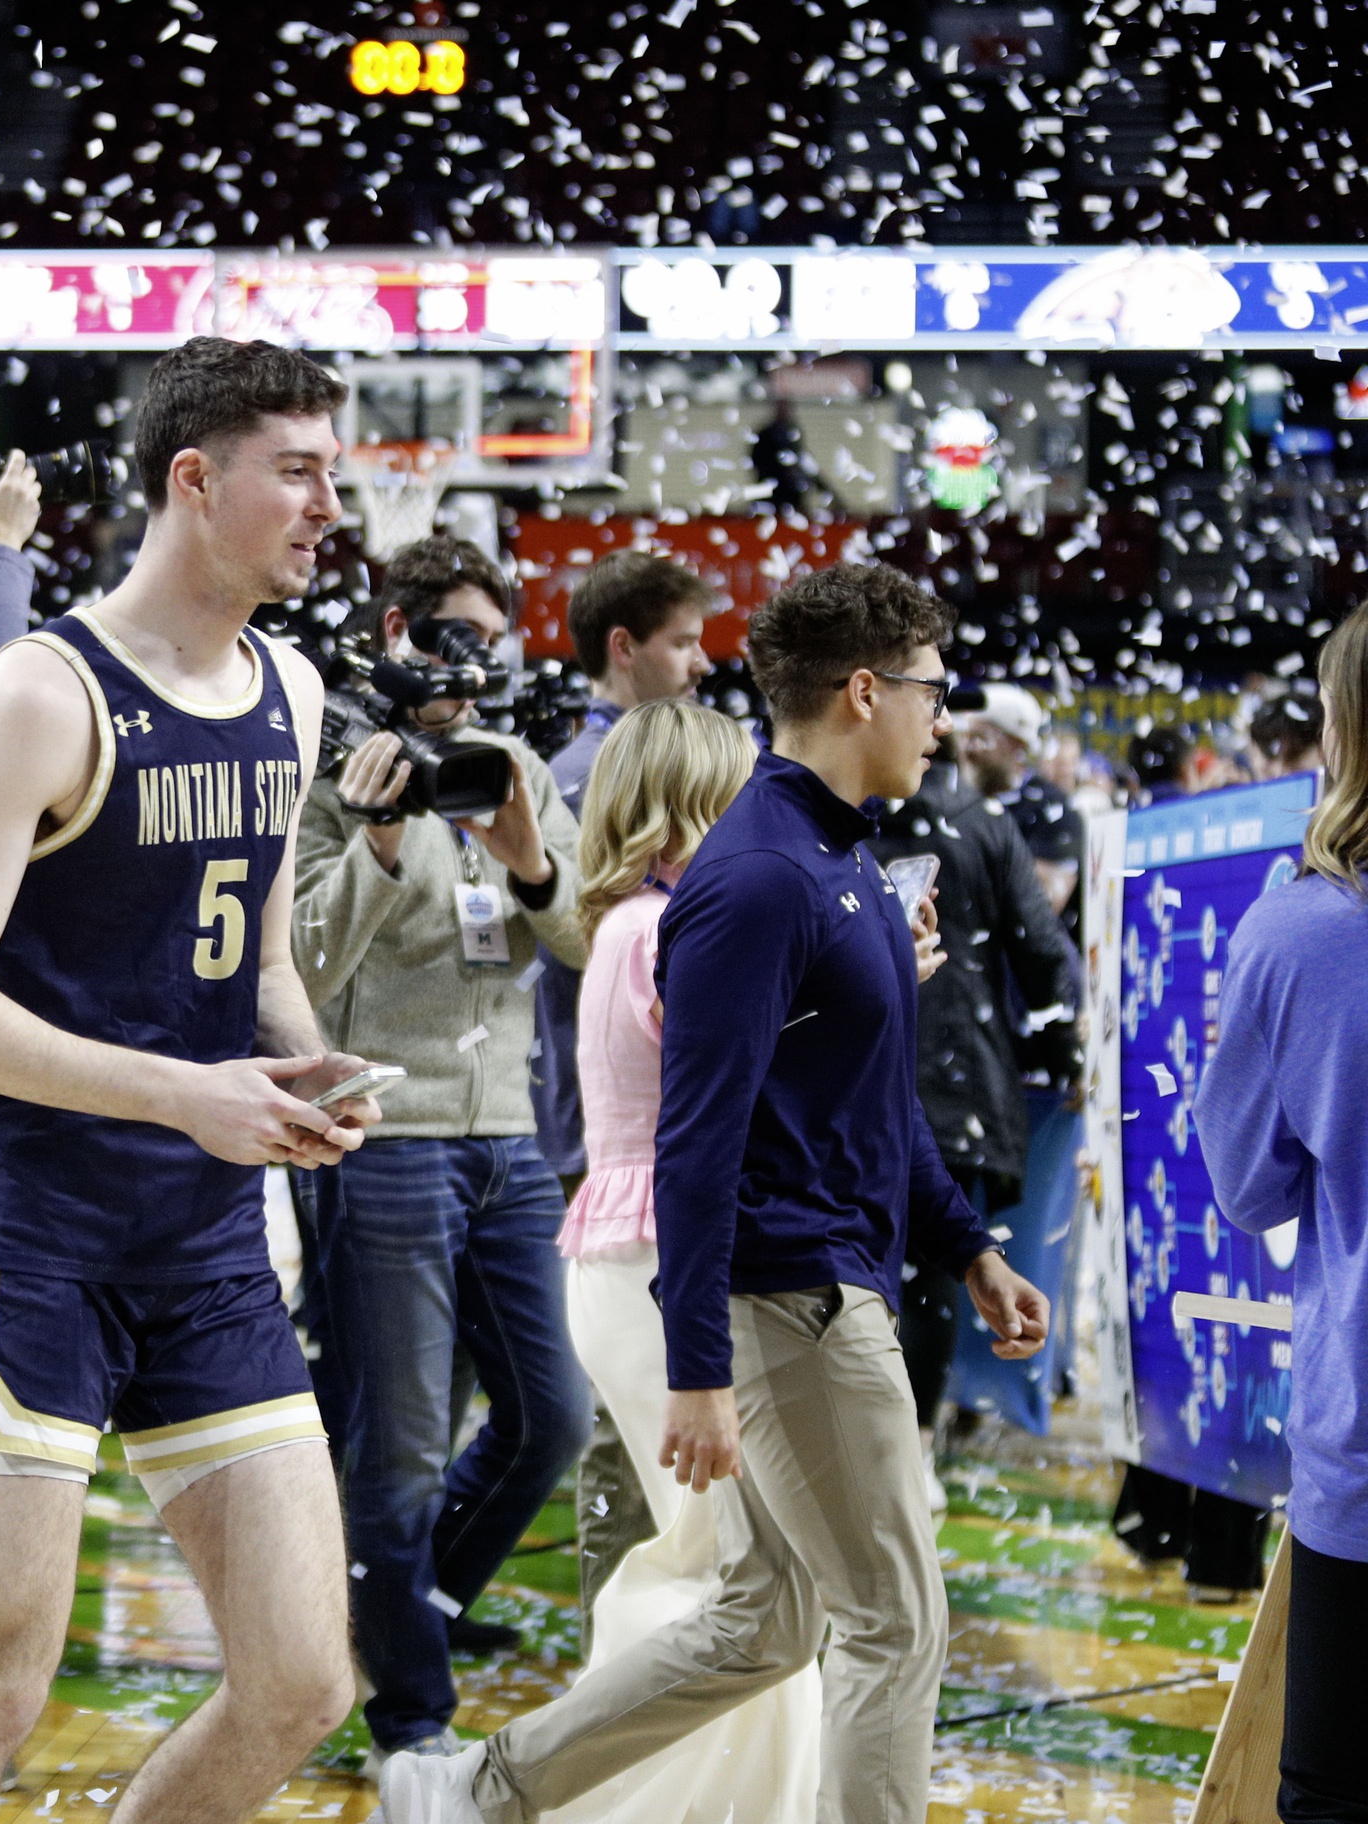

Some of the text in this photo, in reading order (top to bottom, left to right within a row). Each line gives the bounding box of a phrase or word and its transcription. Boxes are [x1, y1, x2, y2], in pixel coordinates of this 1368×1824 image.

[138, 760, 298, 846] MONTANA STATE
[192, 859, 249, 980] 5
